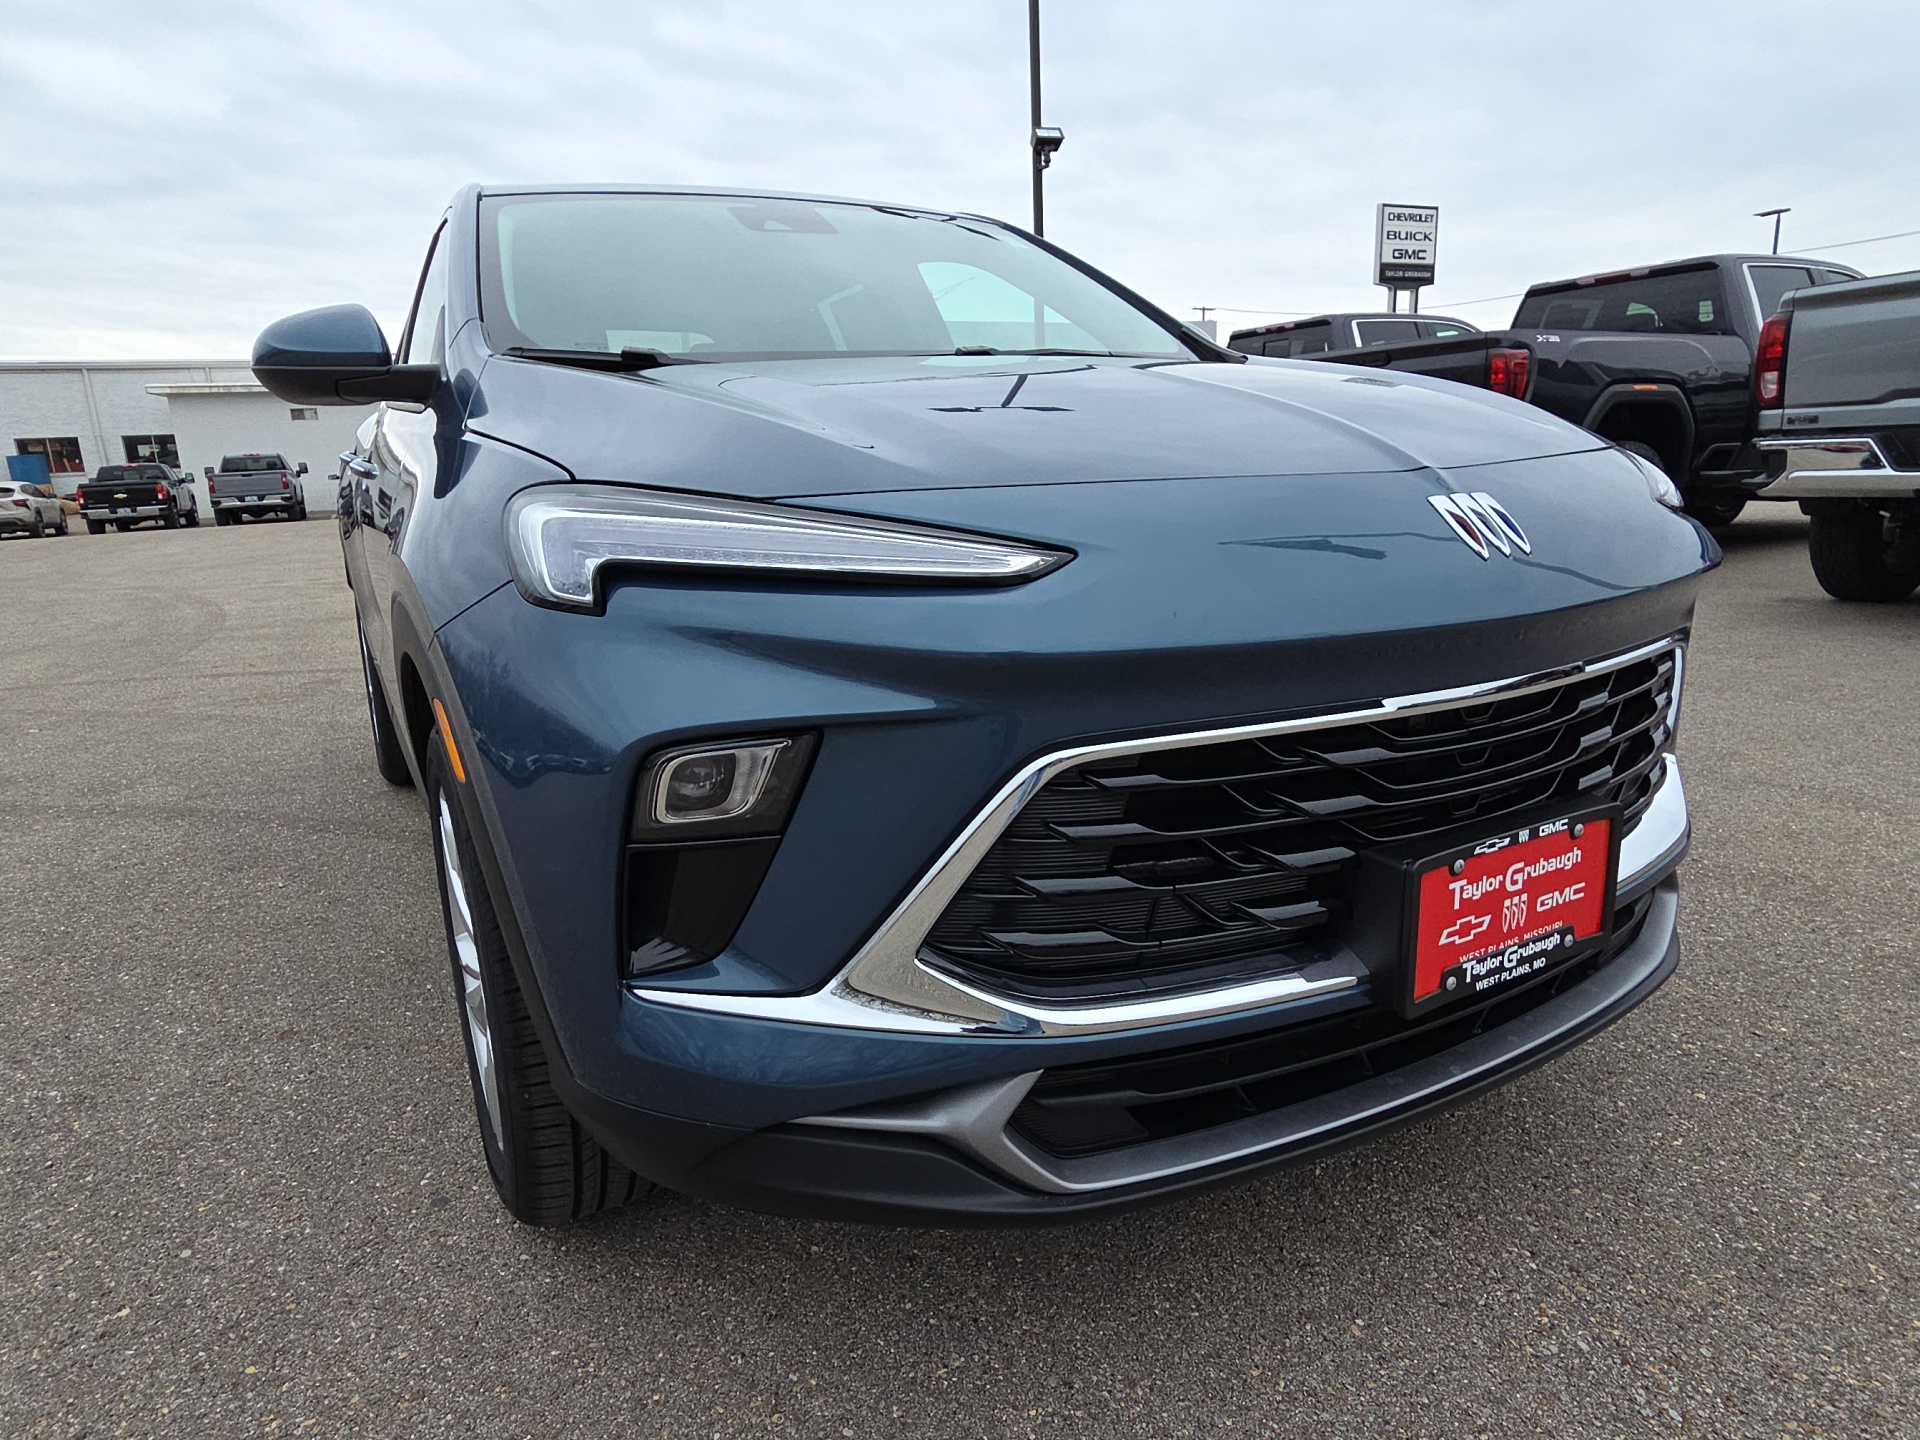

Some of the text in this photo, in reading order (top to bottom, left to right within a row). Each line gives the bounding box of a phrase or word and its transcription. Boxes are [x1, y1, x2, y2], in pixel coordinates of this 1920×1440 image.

[1388, 212, 1434, 223] CHEVROLET
[1386, 230, 1433, 242] BUICK
[1392, 248, 1427, 260] GMC
[1539, 819, 1568, 836] GMC
[1449, 846, 1581, 910] Taylor Grubaugh
[1536, 882, 1585, 912] GMC
[1462, 932, 1561, 983] Taylor Grubaugh
[1475, 957, 1546, 991] WEST PLAINS, MO
